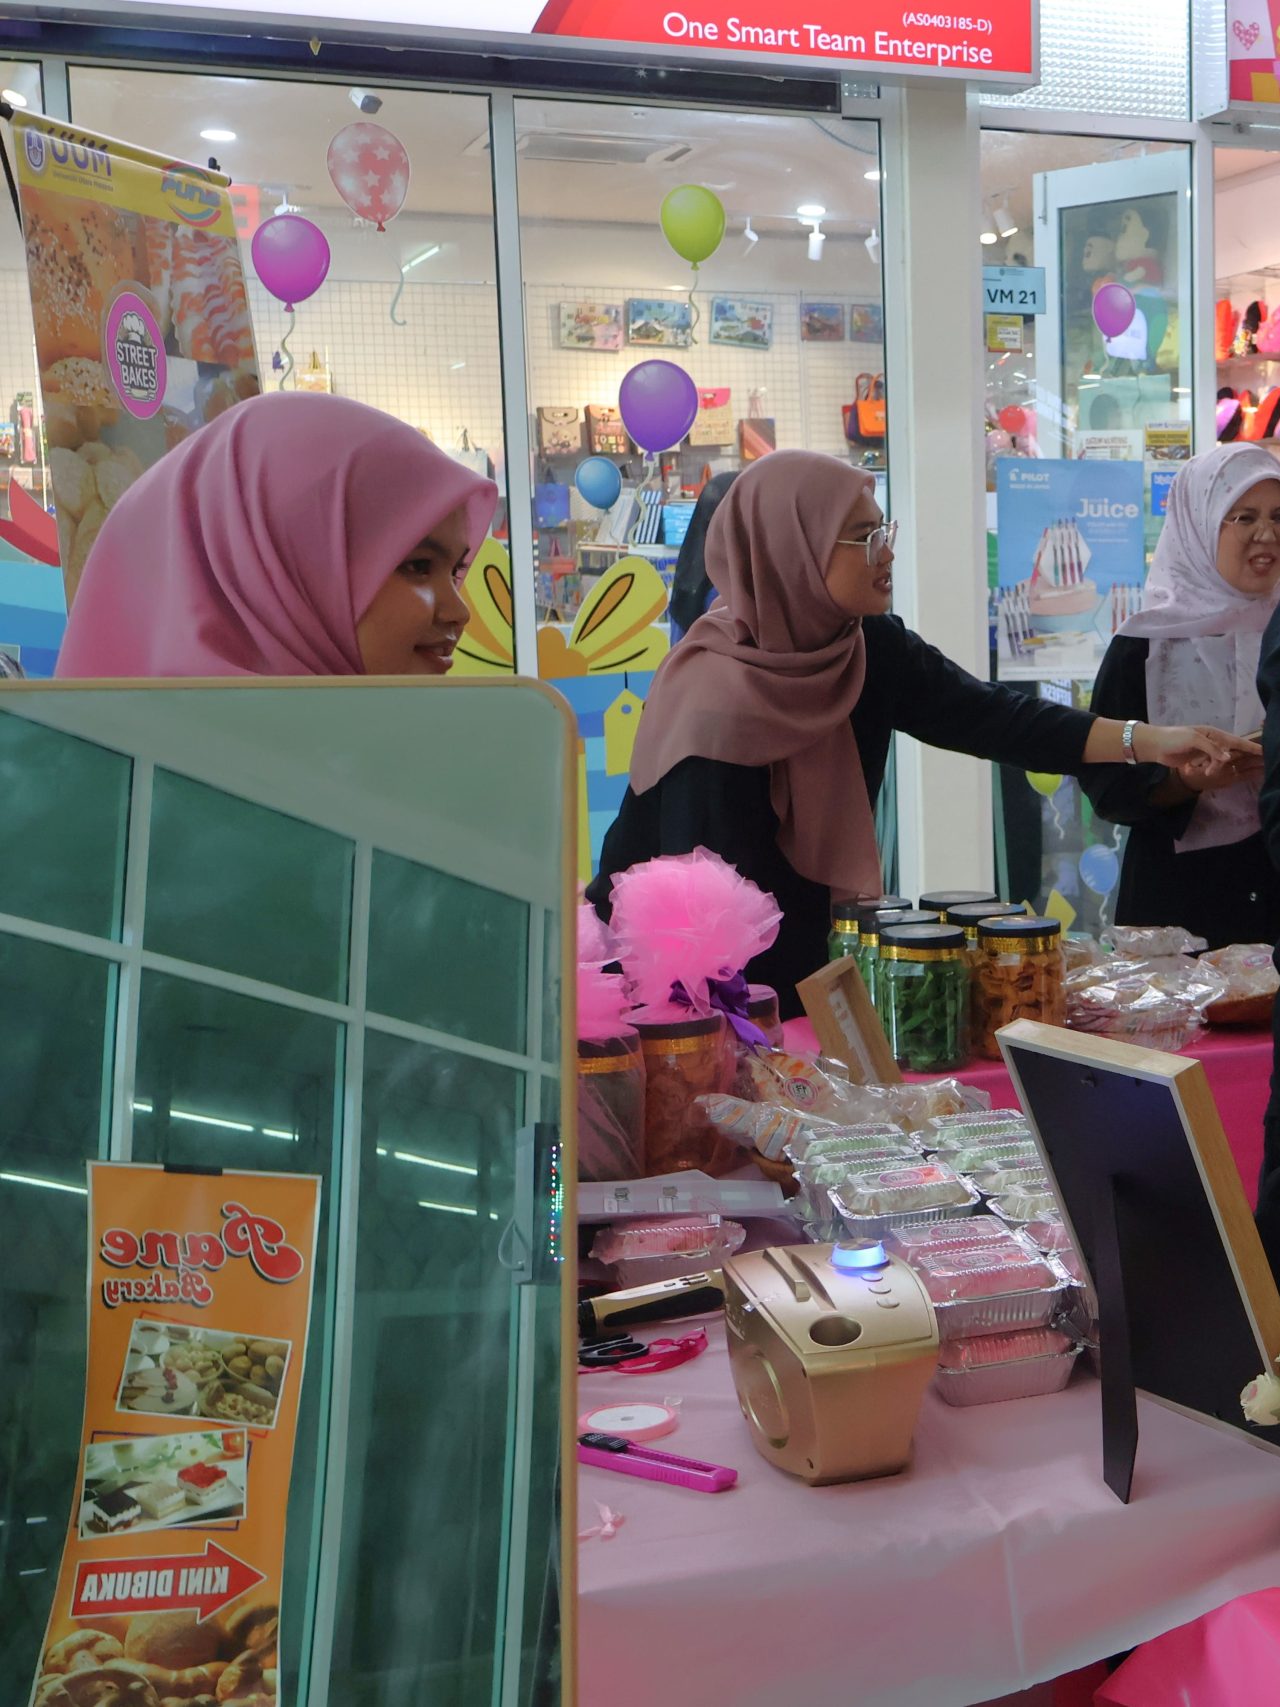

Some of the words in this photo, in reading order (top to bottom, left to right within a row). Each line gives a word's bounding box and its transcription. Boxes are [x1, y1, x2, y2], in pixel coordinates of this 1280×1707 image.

[902, 11, 993, 36] (AS0403185-D)
[662, 11, 719, 41] One
[726, 17, 800, 49] Smart
[803, 24, 866, 54] Team
[874, 30, 993, 67] Enterprise
[47, 127, 113, 177] UUM
[986, 288, 1014, 304] VM
[1018, 290, 1037, 305] 21
[116, 341, 158, 368] STREET
[121, 366, 157, 389] BAKES
[1021, 472, 1051, 482] PILOT
[1076, 498, 1140, 518] Juice
